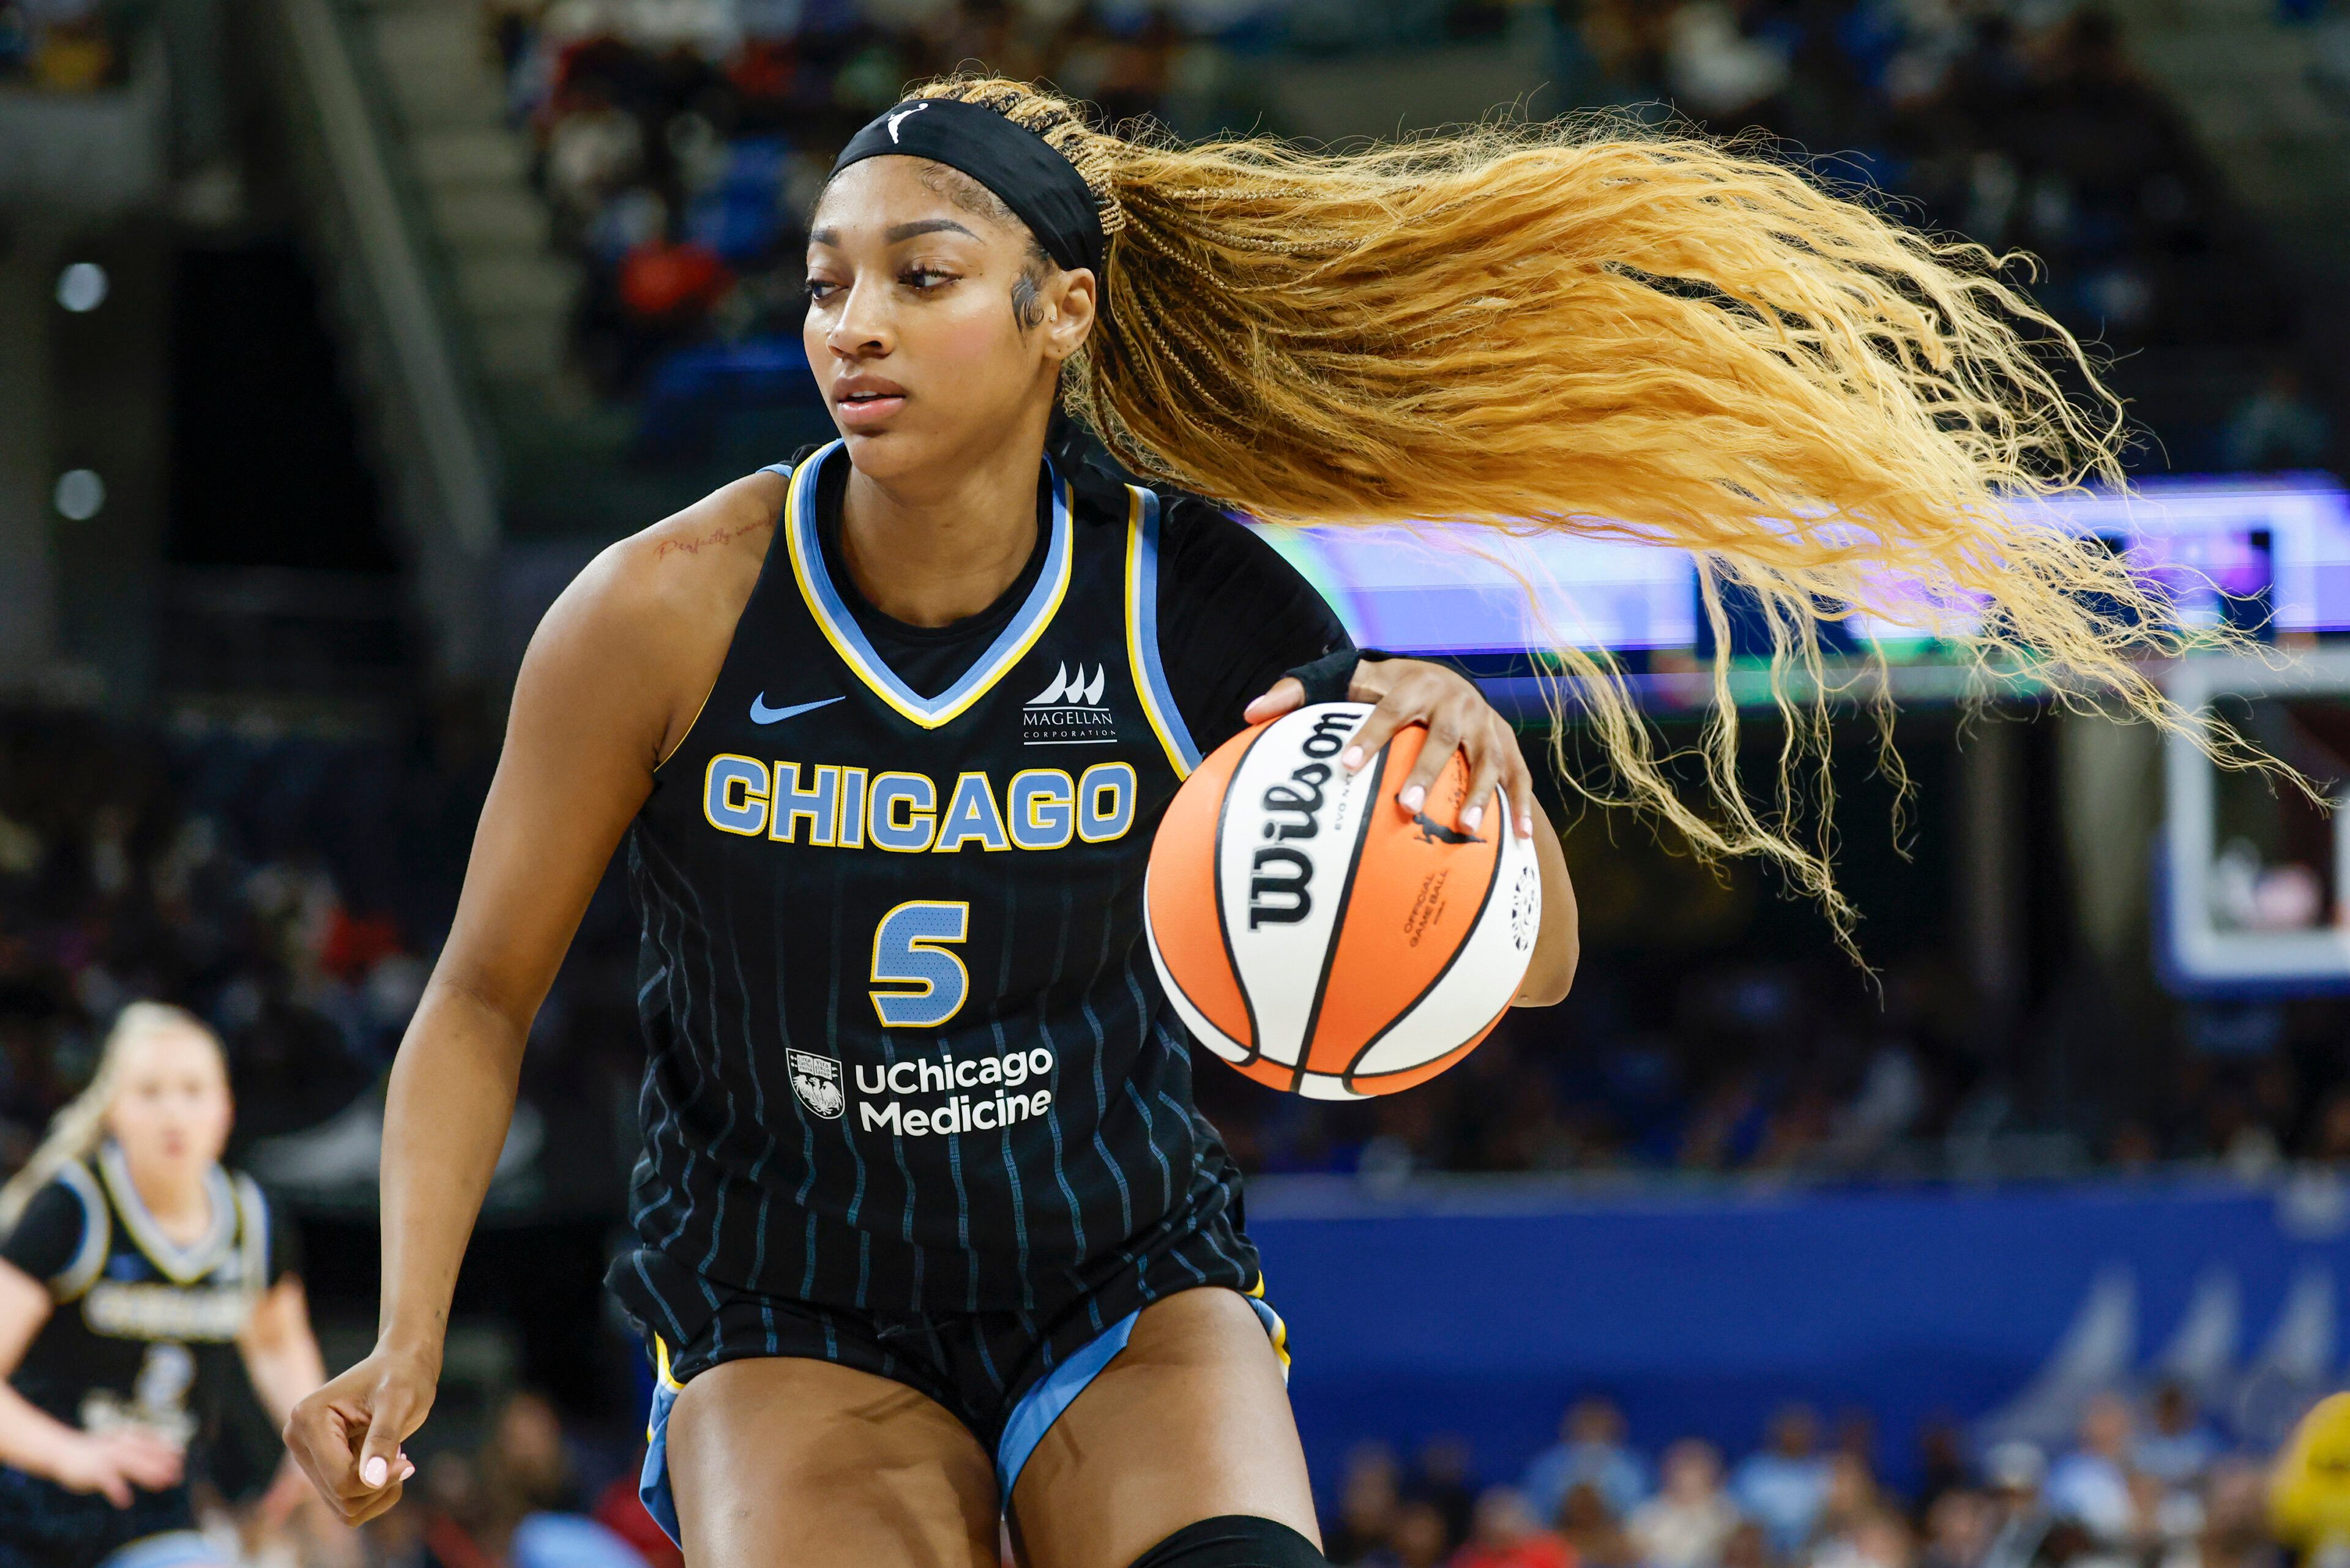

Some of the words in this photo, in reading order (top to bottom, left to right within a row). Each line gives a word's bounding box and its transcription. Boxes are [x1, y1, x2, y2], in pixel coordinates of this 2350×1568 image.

[1023, 711, 1113, 726] MAGELLAN
[1023, 730, 1116, 738] CORPORATION
[703, 753, 1137, 853] CHICAGO
[1248, 712, 1363, 933] Wilson
[1334, 802, 1346, 831] EVO
[1404, 873, 1435, 934] OFFICIAL
[1409, 906, 1434, 947] GAME
[1430, 869, 1449, 905] BALL
[868, 900, 969, 1028] 5
[855, 1048, 1053, 1094] UChicago
[859, 1089, 1052, 1137] Medicine
